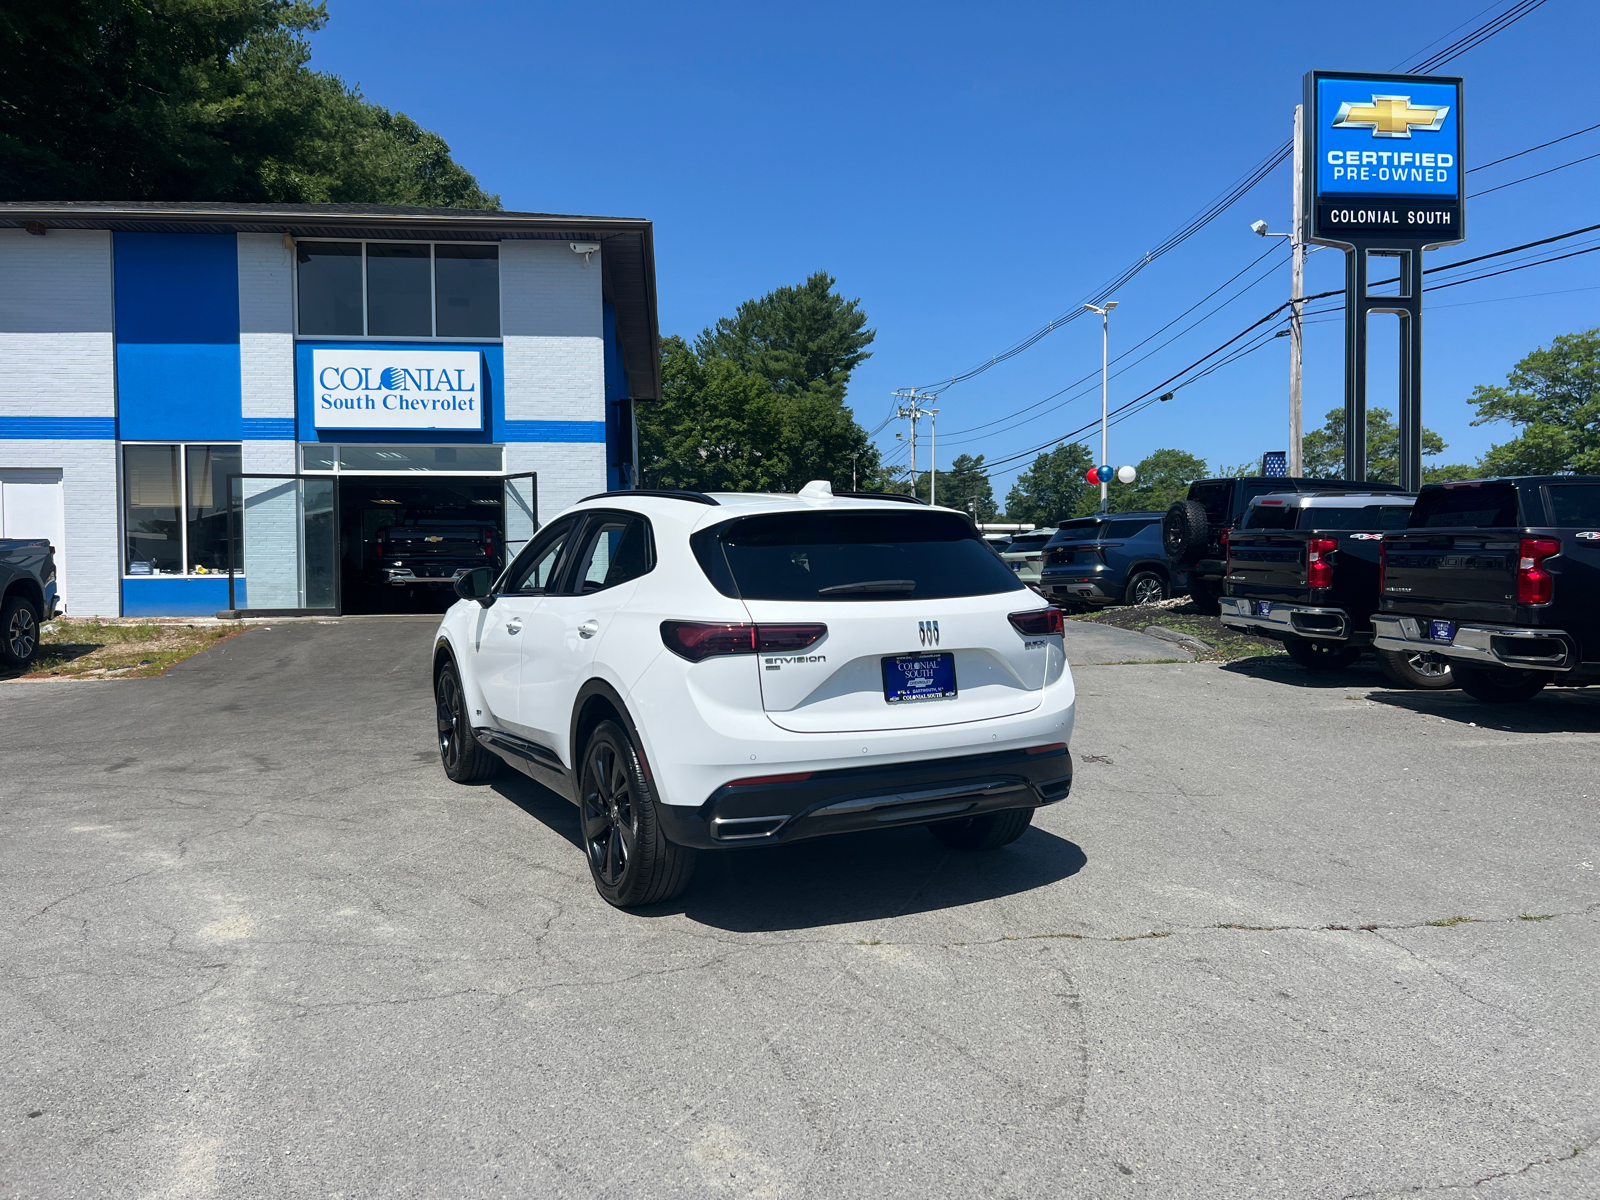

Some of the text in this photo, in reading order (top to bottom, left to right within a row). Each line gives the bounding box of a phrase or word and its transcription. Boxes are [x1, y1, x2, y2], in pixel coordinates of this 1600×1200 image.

[1327, 150, 1453, 167] CERTIFIED
[1334, 167, 1448, 182] PRE-OWNED
[1330, 209, 1451, 225] COLONIAL SOUTH
[319, 366, 475, 392] COLONIAL
[321, 393, 475, 411] South Chevrolet
[764, 655, 827, 665] ENVISION
[898, 661, 939, 670] COLONIAL
[904, 669, 934, 678] SOUTH
